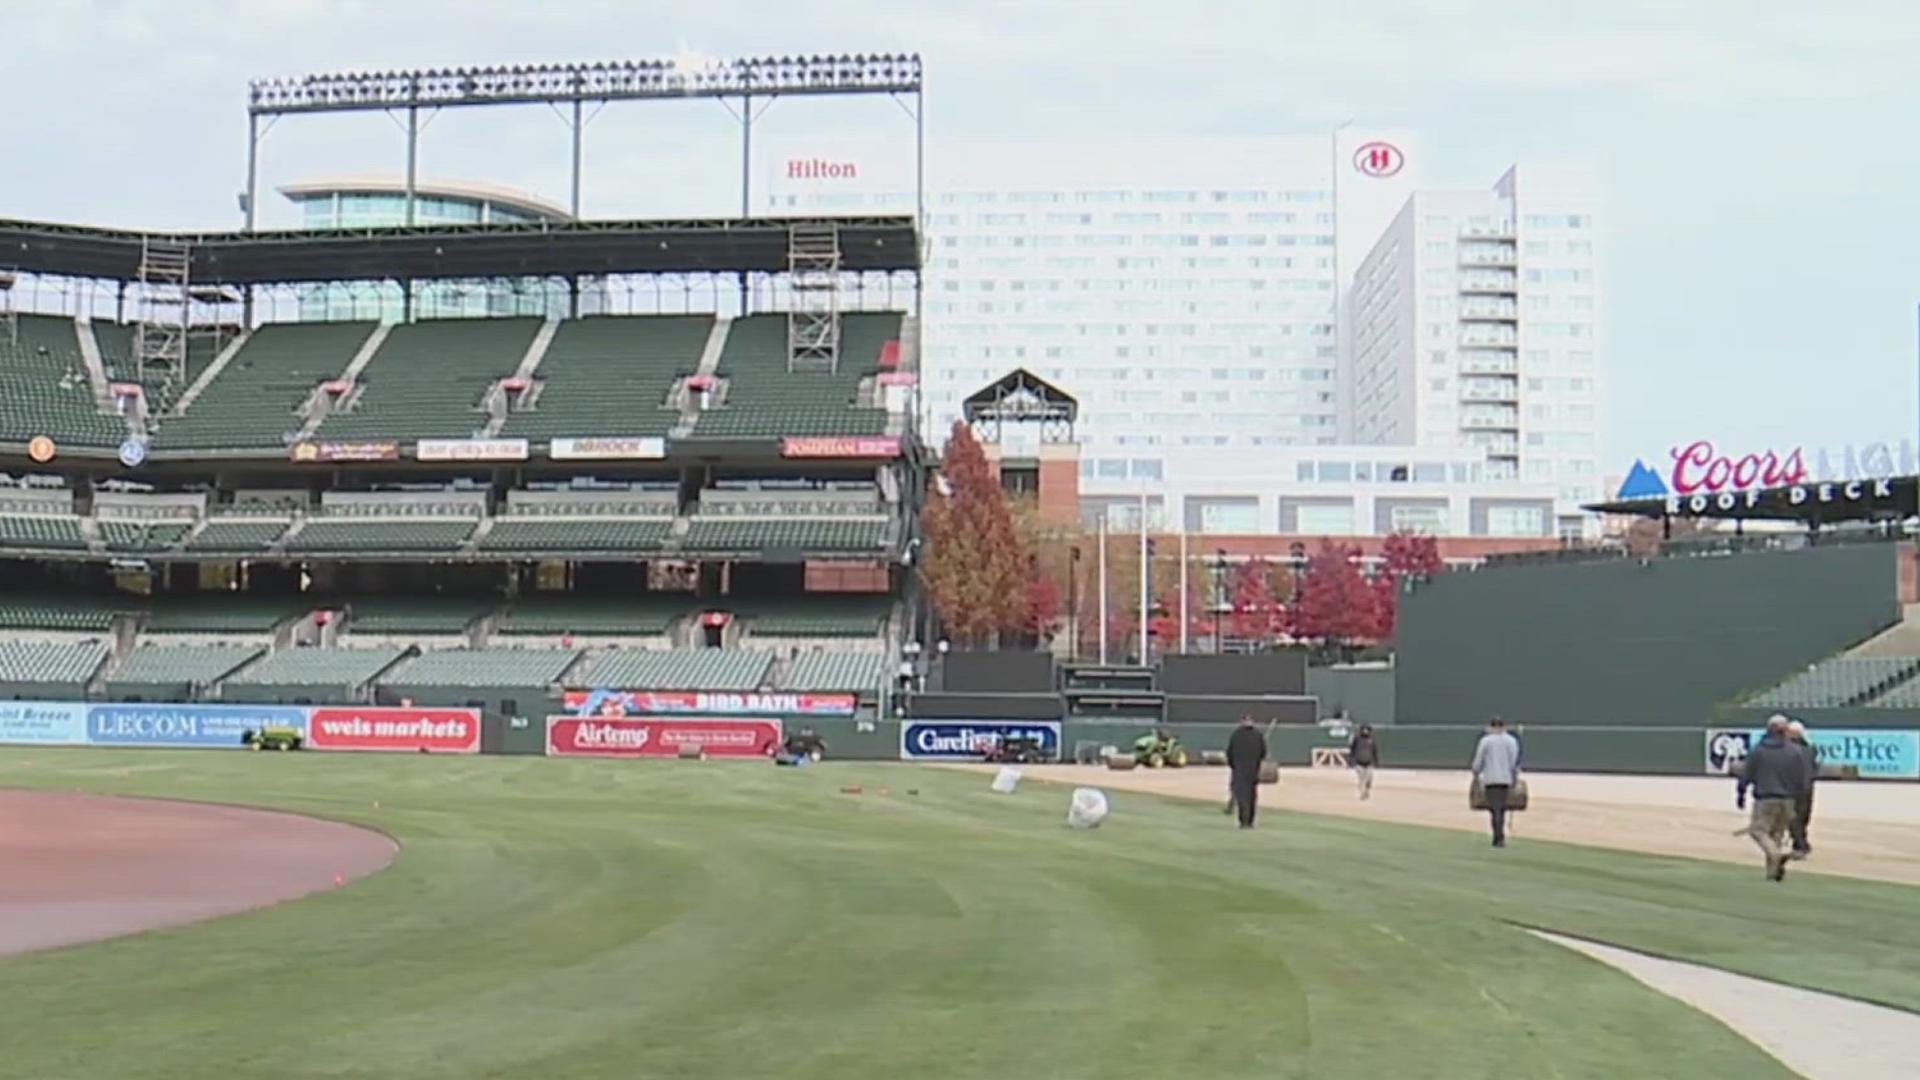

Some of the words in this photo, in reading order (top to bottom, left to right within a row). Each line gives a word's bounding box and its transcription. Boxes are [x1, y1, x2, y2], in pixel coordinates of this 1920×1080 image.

[787, 158, 856, 178] Hilton
[1670, 440, 1808, 494] Coors
[1665, 490, 1761, 514] ROOF
[1789, 479, 1891, 505] DECK
[697, 693, 743, 709] BIRD
[746, 693, 797, 709] BATH
[322, 718, 371, 736] weis
[375, 717, 467, 738] markets
[574, 722, 648, 746] Airtemp
